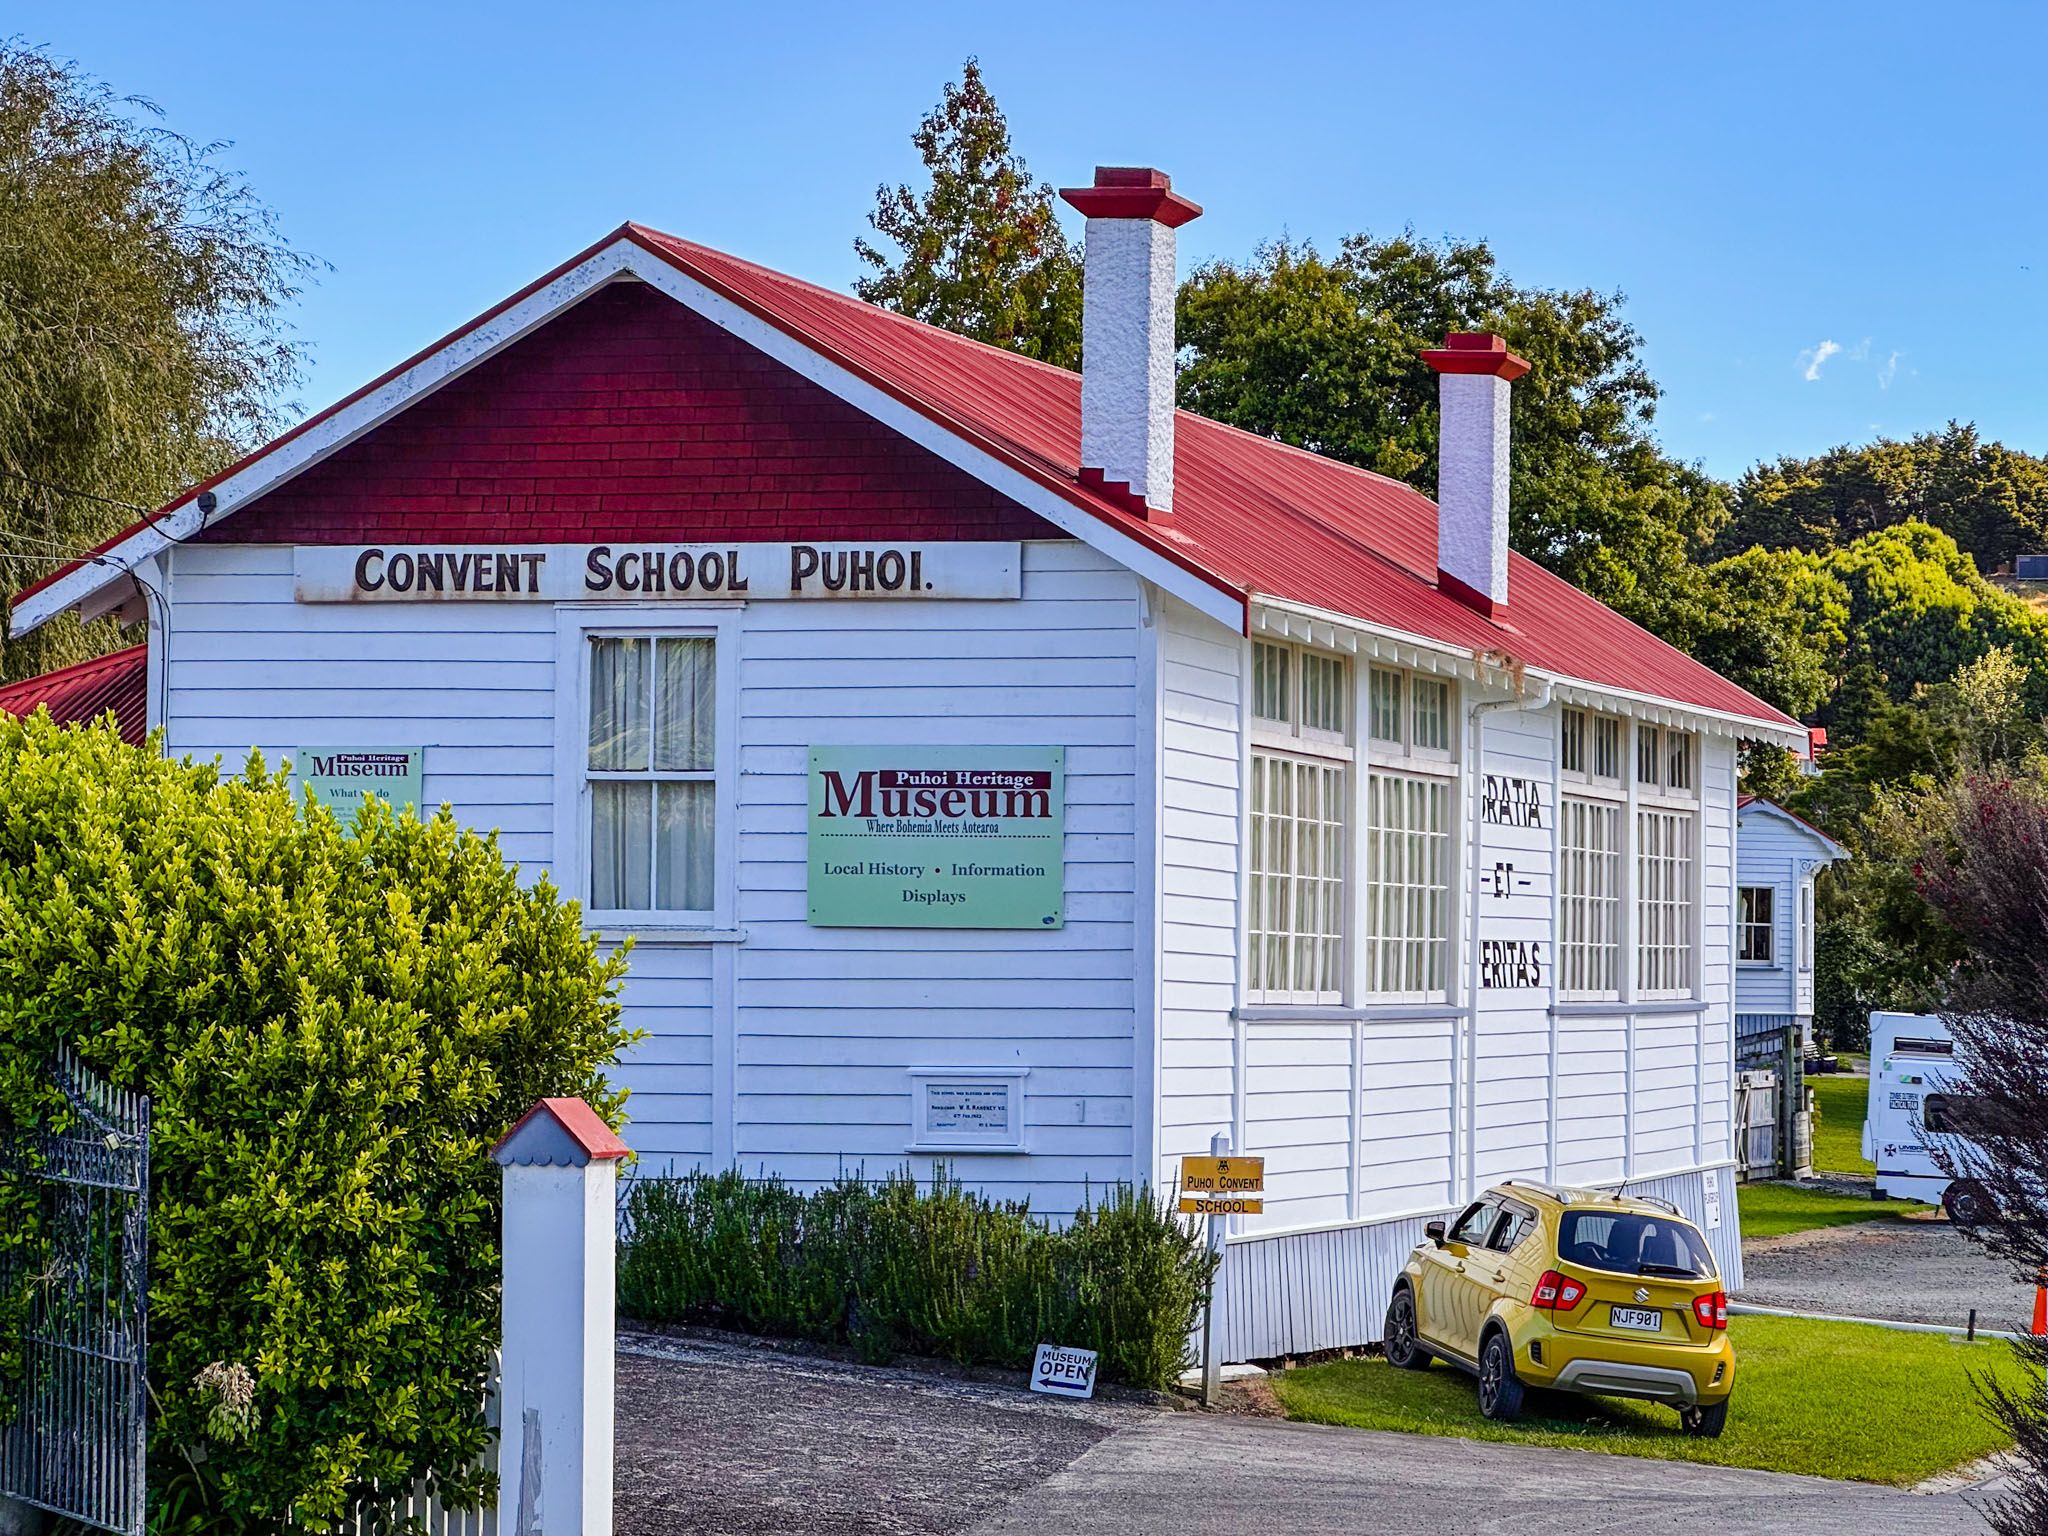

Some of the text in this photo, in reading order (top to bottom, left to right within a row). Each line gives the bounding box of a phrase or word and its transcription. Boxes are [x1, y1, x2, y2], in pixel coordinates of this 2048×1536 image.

[355, 545, 934, 595] CONVENT SCHOOL PUHOI.
[310, 756, 409, 777] Museum
[340, 754, 405, 763] Puhoi Heritage
[896, 771, 1034, 789] Puhoi Heritage
[329, 788, 357, 798] What
[376, 788, 390, 798] do
[817, 771, 1053, 819] Museum
[866, 819, 999, 834] Where Bohemia Meets Aotearoa
[824, 862, 1046, 879] Local History Information
[902, 889, 967, 906] Displays
[1481, 941, 1540, 988] ERITAS
[1187, 1176, 1260, 1189] PUHOI CONVENT
[1196, 1199, 1249, 1213] SCHOOL
[1613, 1309, 1658, 1327] NJF901
[1041, 1350, 1092, 1366] MUSEUM
[1040, 1361, 1089, 1380] OPEN
